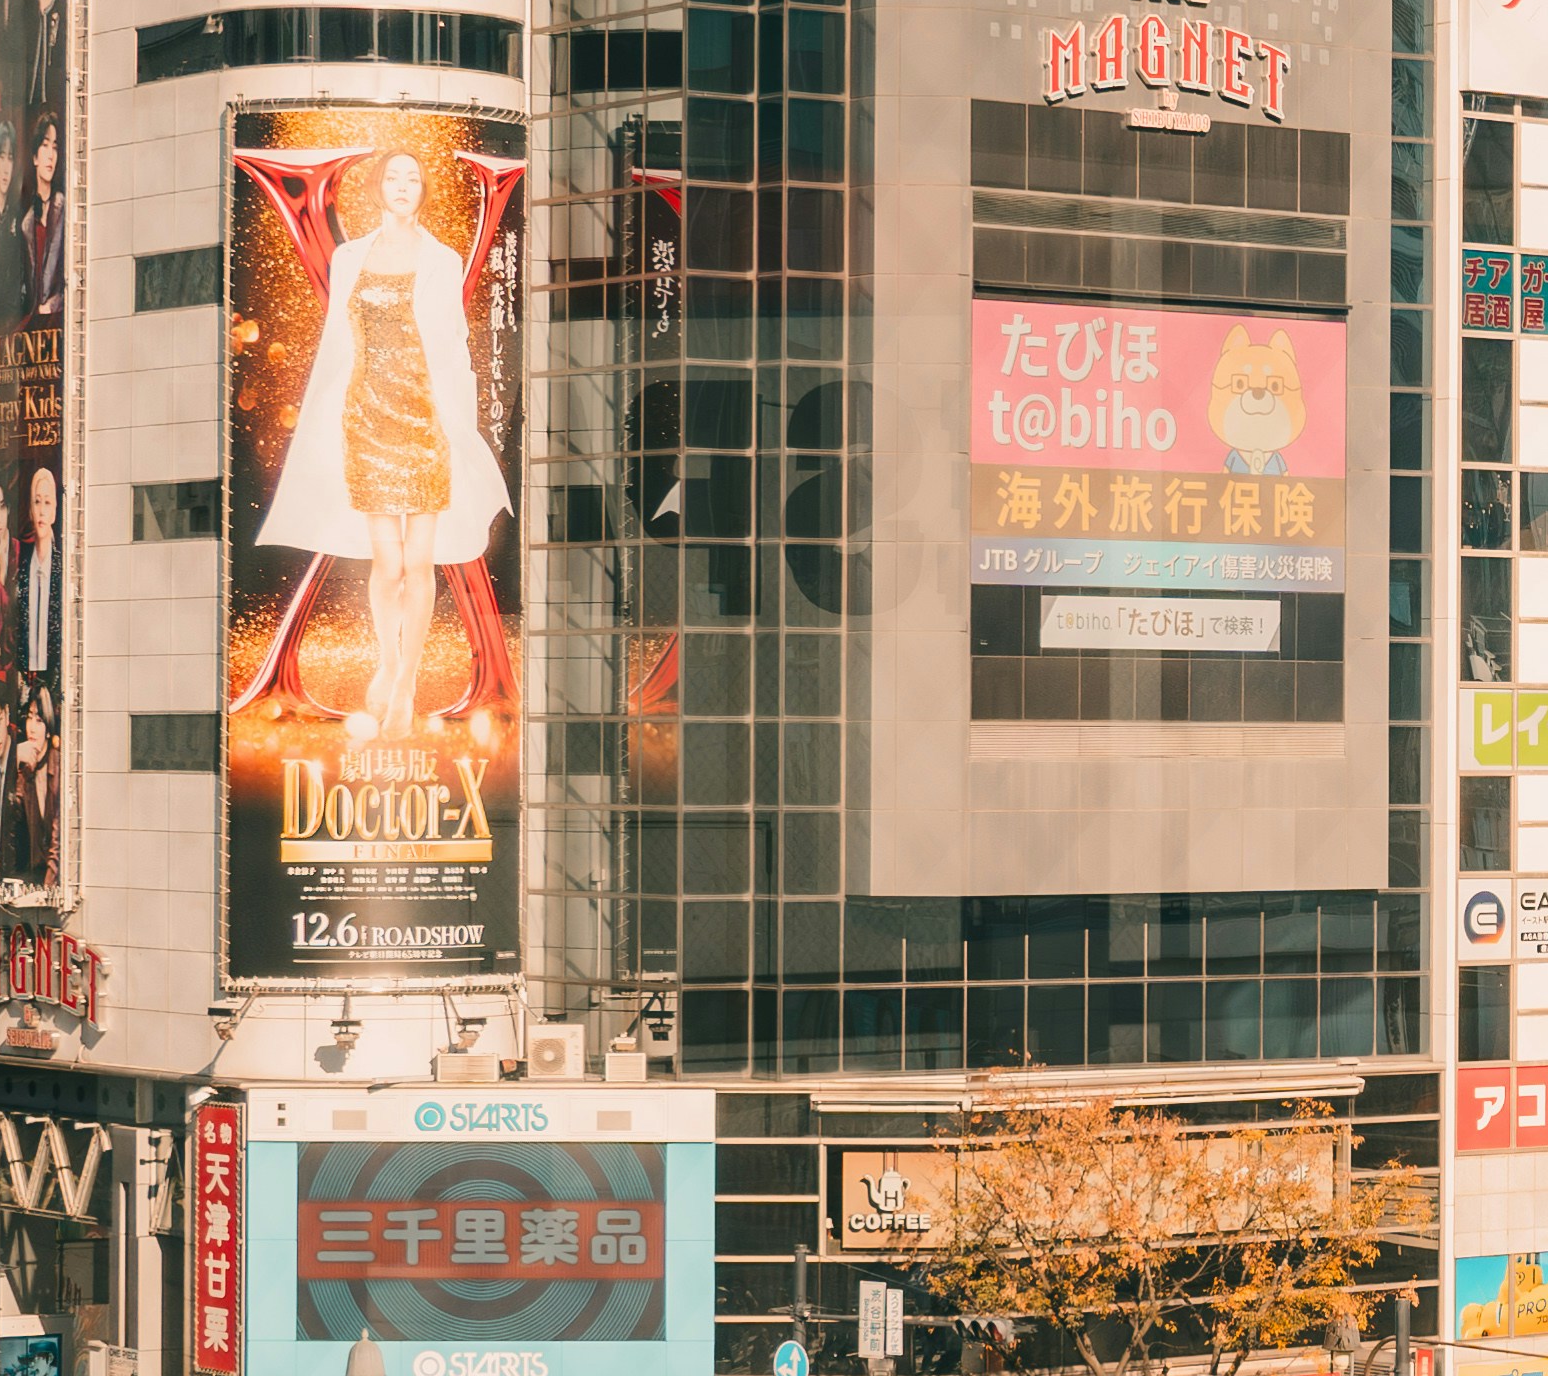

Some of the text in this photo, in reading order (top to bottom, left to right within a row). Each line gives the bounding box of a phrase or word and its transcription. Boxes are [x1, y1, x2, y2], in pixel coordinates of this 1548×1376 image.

[1046, 15, 1291, 120] MAGNET
[1464, 295, 1545, 329] 居酒屋
[1001, 314, 1160, 383] たびほ
[21, 384, 63, 421] Kids
[988, 388, 1177, 452] t@biho
[996, 471, 1315, 538] 海外旅行保険
[340, 749, 438, 781] 劇場版
[280, 758, 492, 840] Doctor-X
[292, 912, 485, 947] 12.6 ROADSHOW
[203, 1121, 232, 1144] 名物
[317, 1208, 647, 1265] 三千里薬品
[850, 1213, 932, 1231] COFFEE
[203, 1153, 232, 1354] 天津甘栗
